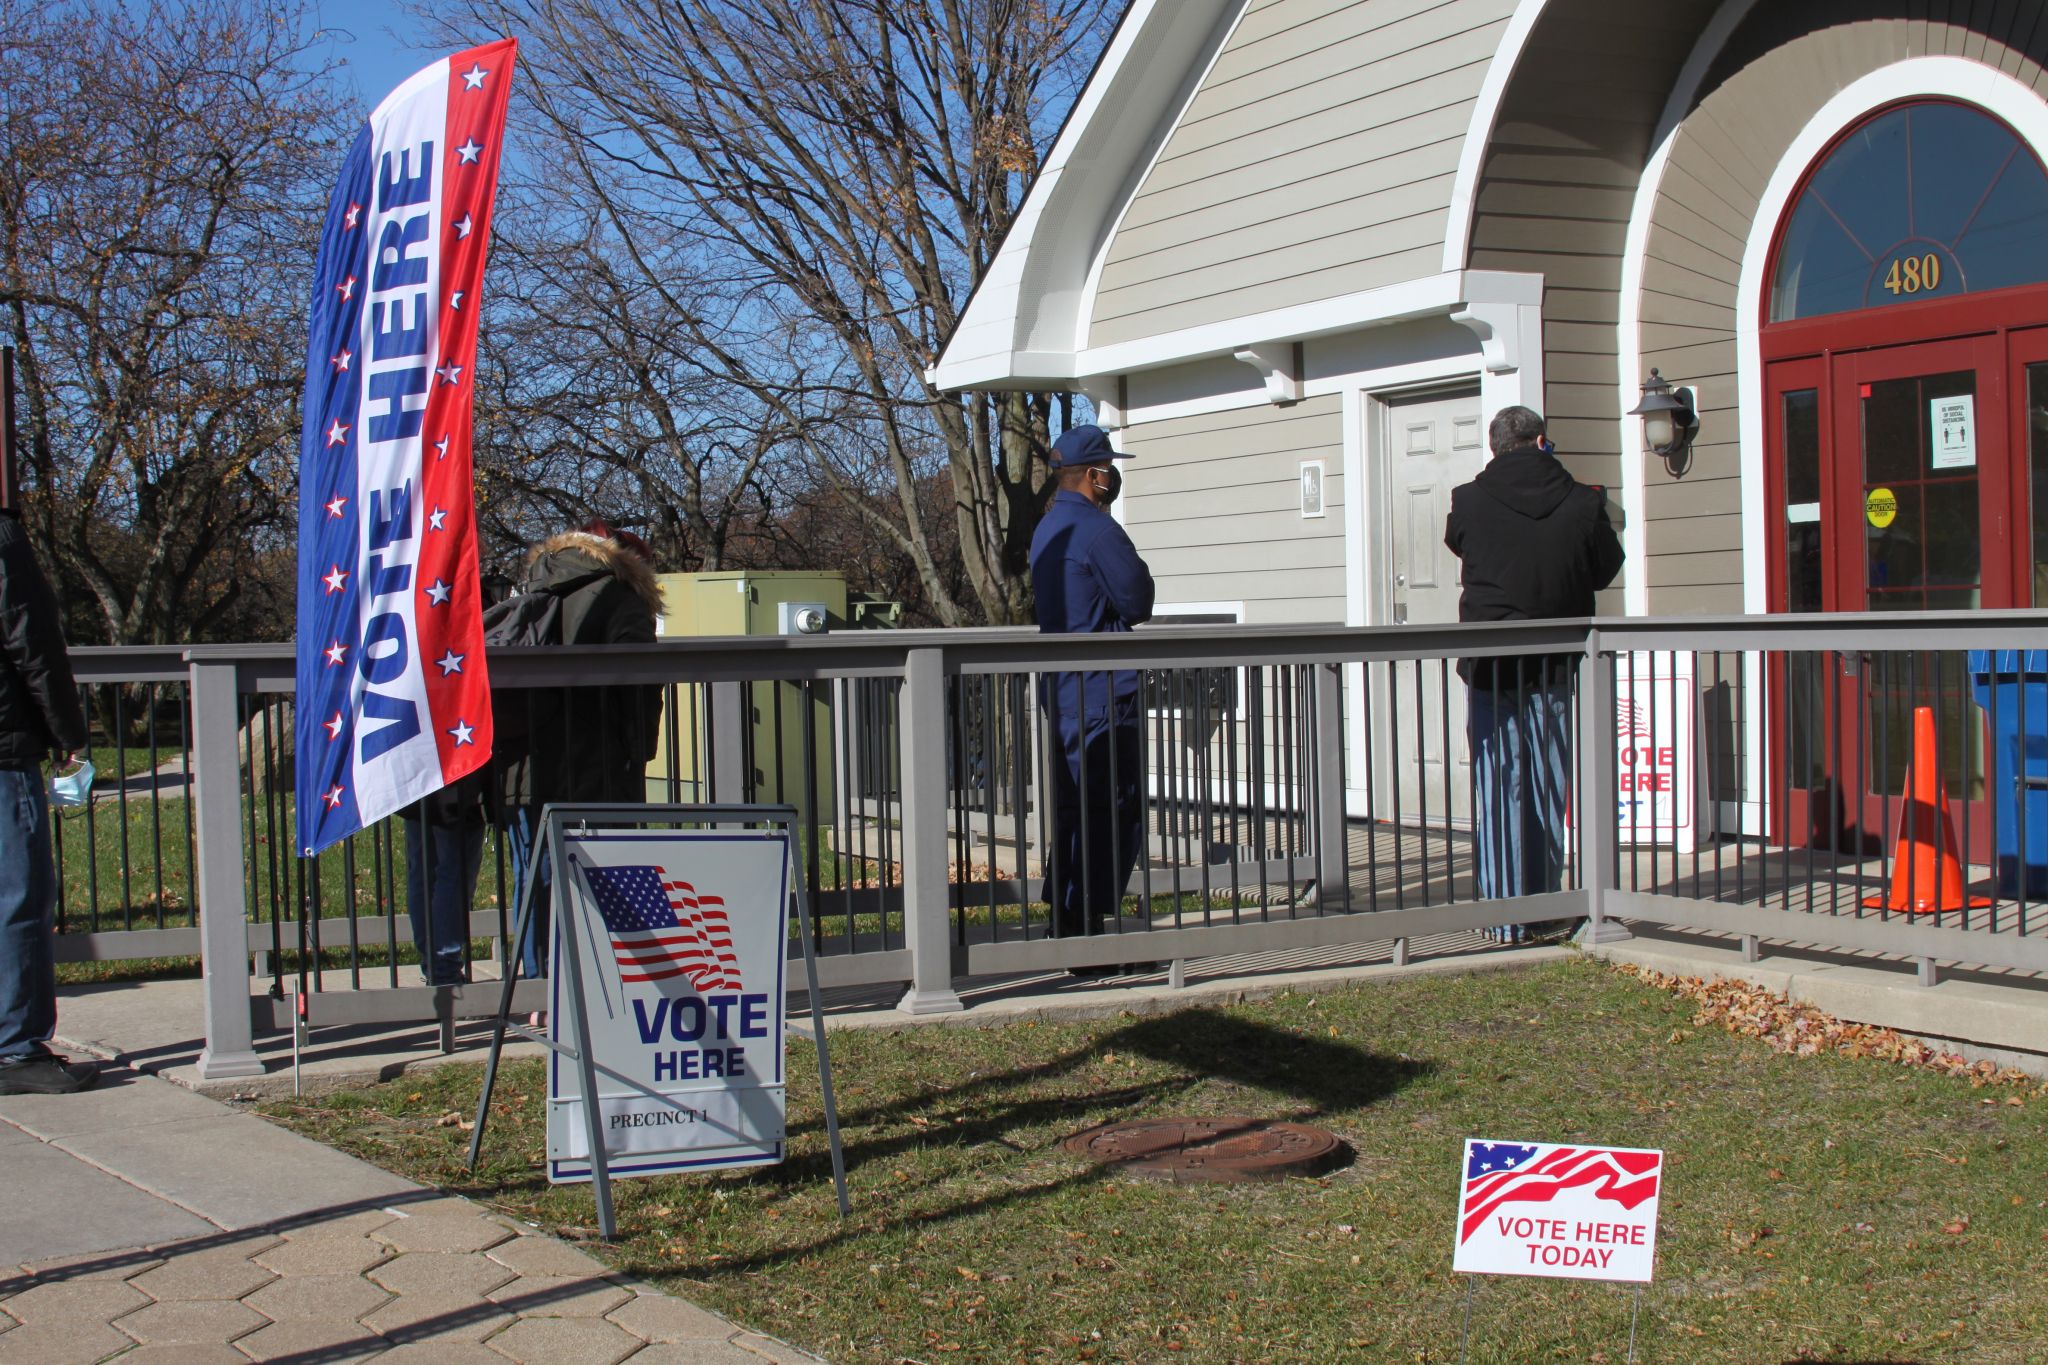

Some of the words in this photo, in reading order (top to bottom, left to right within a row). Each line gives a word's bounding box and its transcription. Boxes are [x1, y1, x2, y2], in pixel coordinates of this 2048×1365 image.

[1883, 253, 1941, 295] 480
[367, 140, 434, 444] HERE
[1866, 503, 1897, 512] CAUTION
[358, 477, 423, 765] VOTE
[1618, 746, 1674, 767] OTE
[1619, 772, 1672, 792] ERE
[632, 993, 769, 1045] VOTE
[654, 1047, 745, 1082] HERE
[609, 1109, 698, 1130] PRECINCT
[701, 1109, 709, 1123] 1
[1497, 1216, 1567, 1241] VOTE
[1575, 1221, 1647, 1246] HERE
[1526, 1243, 1614, 1269] TODAY
